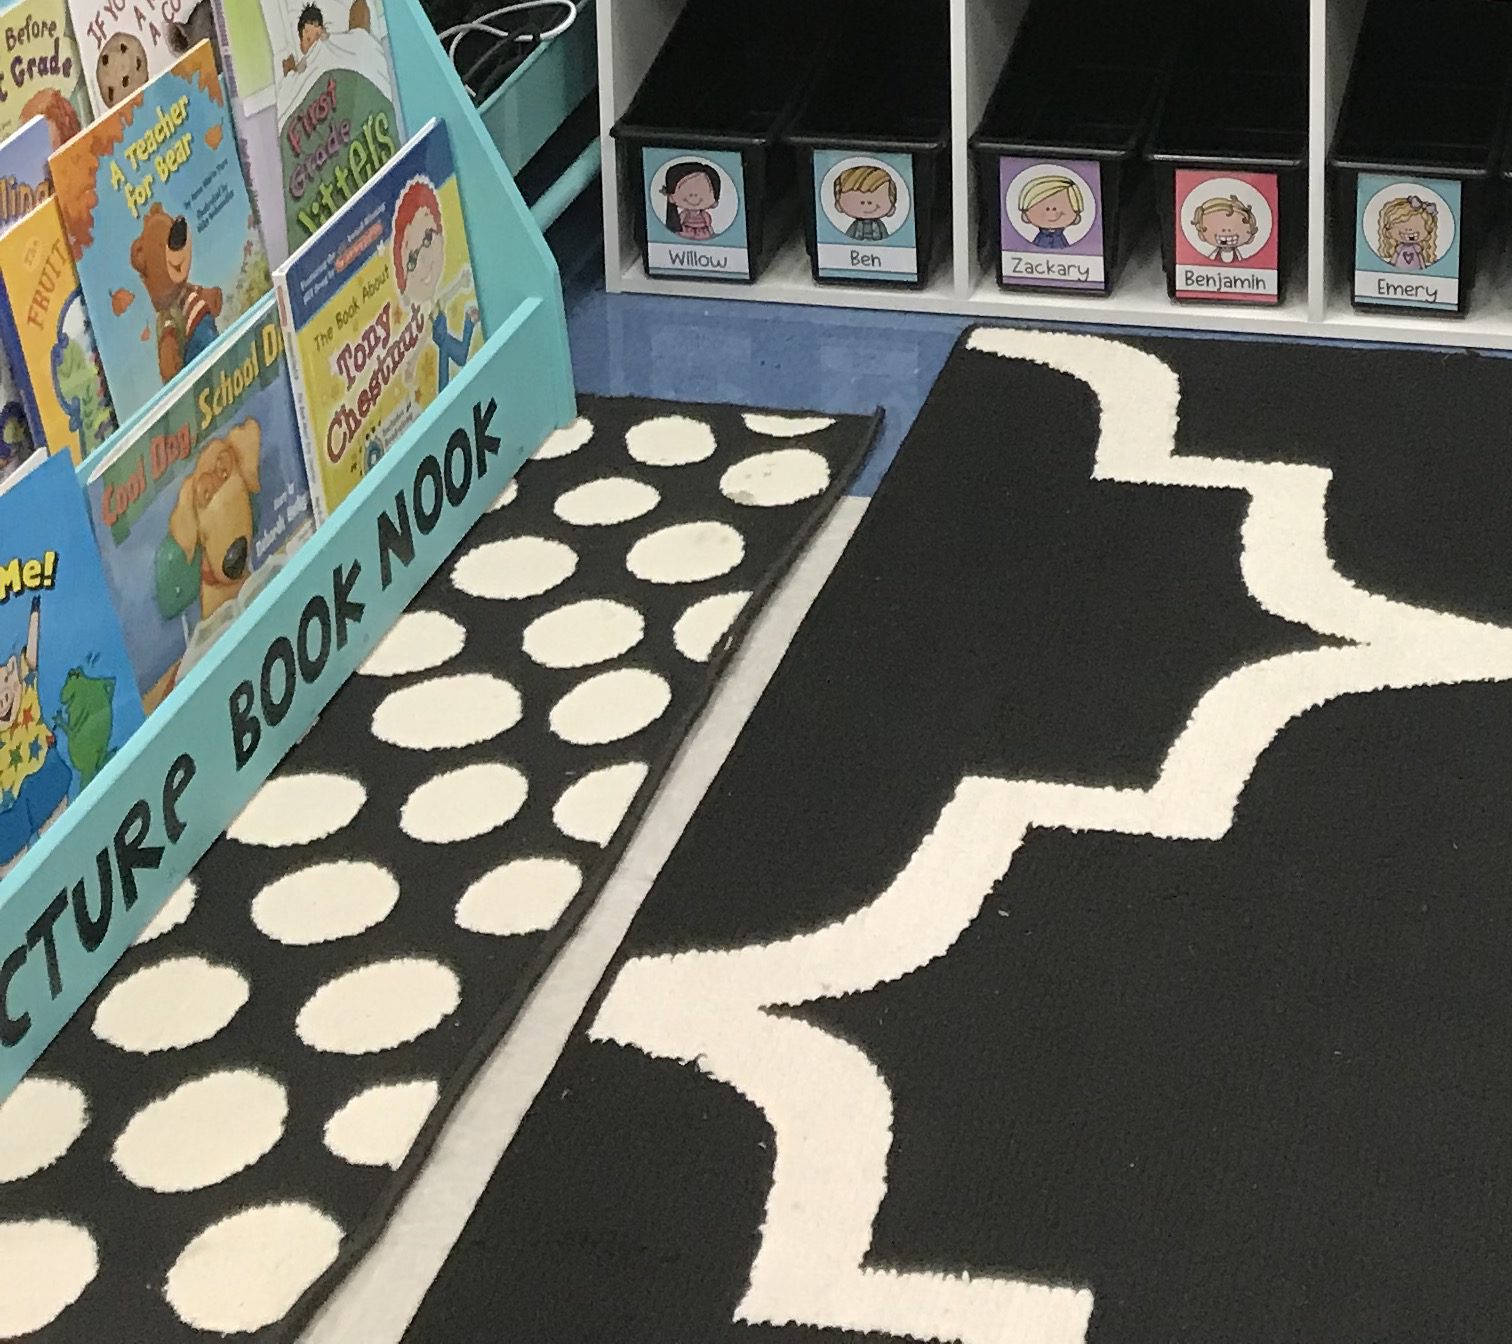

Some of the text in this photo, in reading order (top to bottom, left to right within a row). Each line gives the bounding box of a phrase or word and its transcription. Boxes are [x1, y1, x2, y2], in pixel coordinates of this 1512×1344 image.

[5, 14, 57, 52] Before
[87, 11, 107, 50] IF
[133, 6, 147, 30] A
[148, 22, 162, 46] A
[10, 36, 73, 88] Grade
[286, 75, 338, 157] First
[109, 95, 191, 191] A Teacher
[288, 119, 352, 199] Grade
[124, 131, 194, 219] for Bear
[668, 250, 727, 269] Willow
[851, 251, 882, 269] Ben
[1012, 257, 1091, 282] Zackary
[1185, 270, 1267, 293] Benjamin
[314, 324, 333, 352] The
[336, 297, 359, 328] Book
[362, 264, 391, 306] About
[1376, 279, 1439, 303] Emery
[336, 302, 392, 391] Tony
[326, 303, 425, 465] Chestnut
[101, 452, 148, 527] Cool
[149, 423, 198, 481] Dog,
[198, 341, 260, 430] School
[228, 559, 366, 771] BOOK
[377, 398, 500, 591] NOOK
